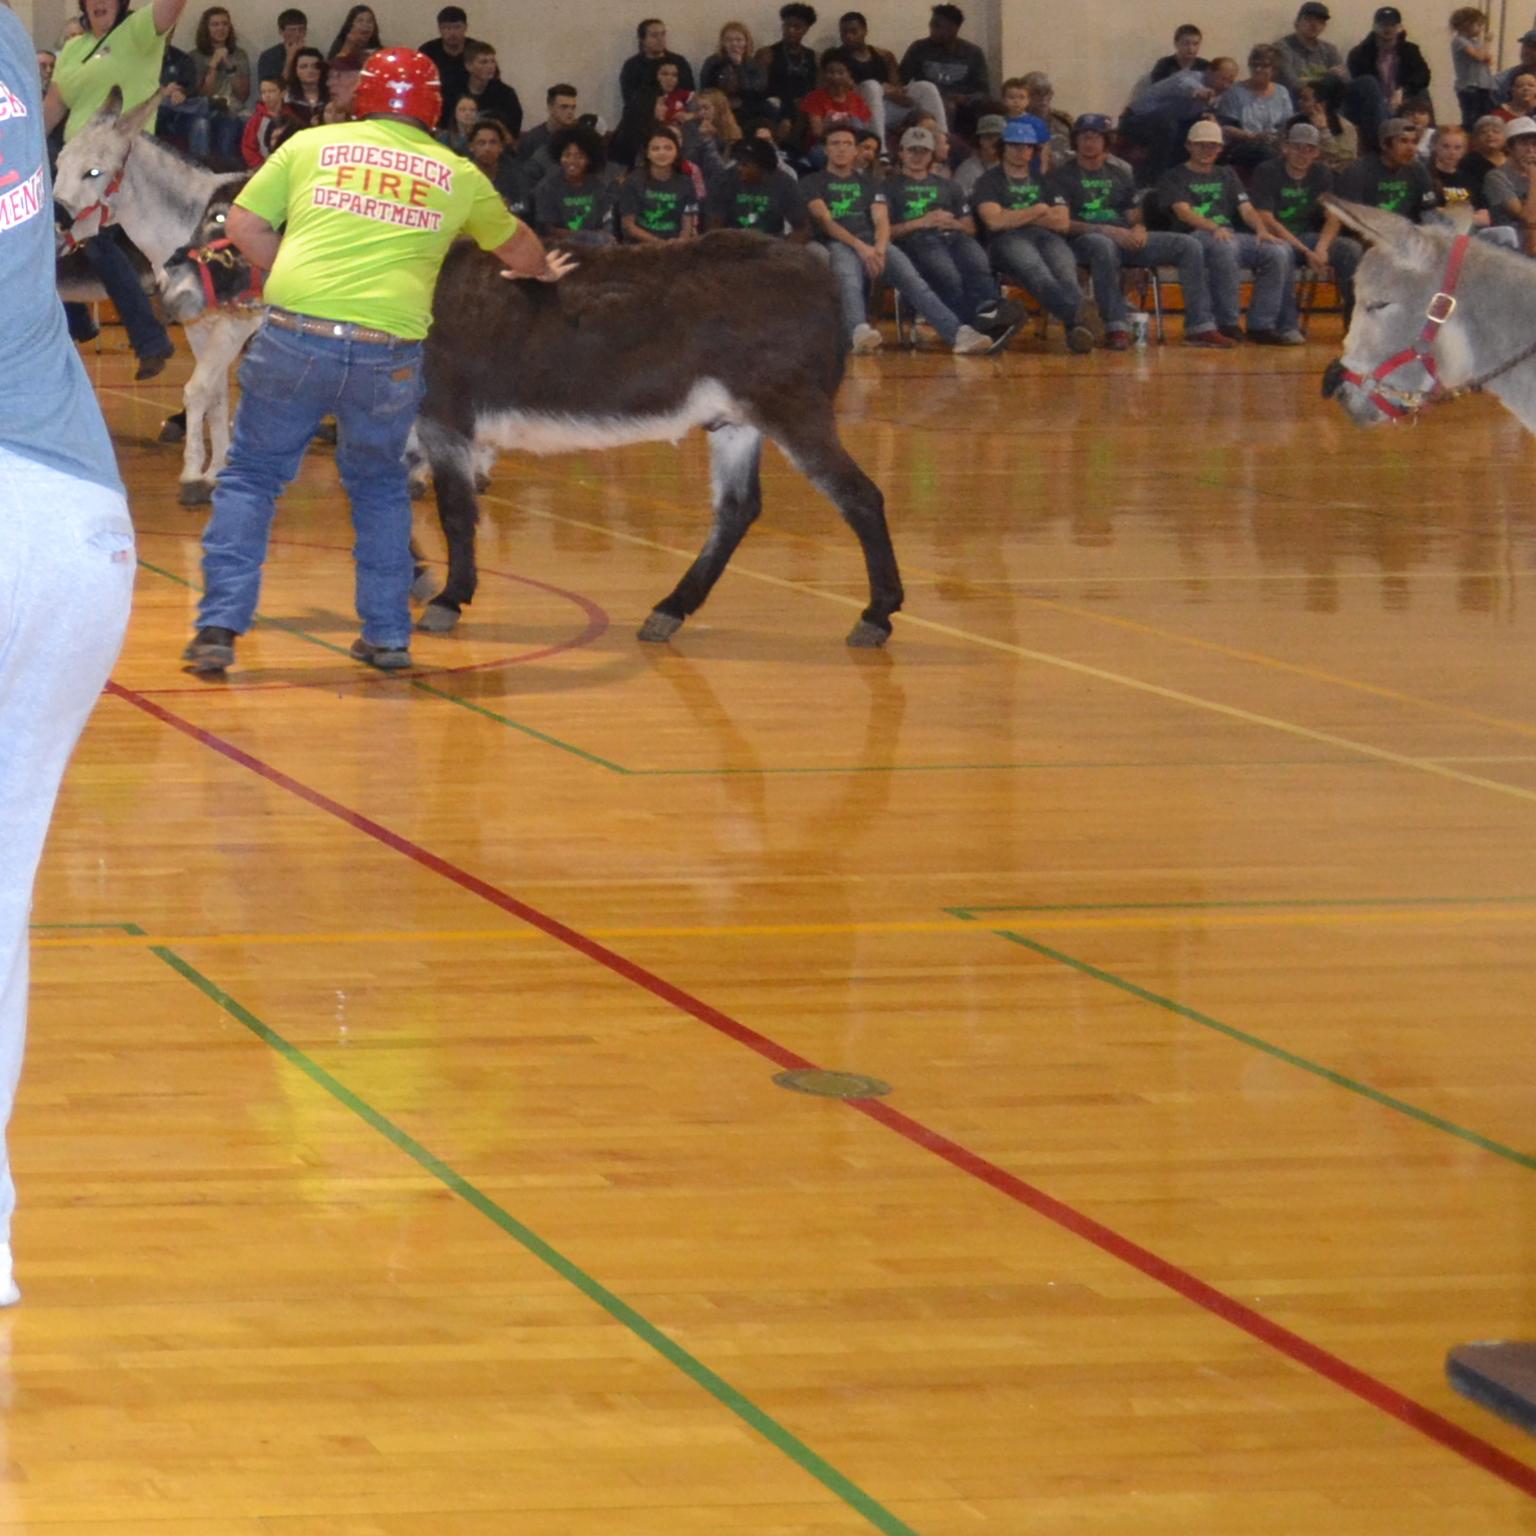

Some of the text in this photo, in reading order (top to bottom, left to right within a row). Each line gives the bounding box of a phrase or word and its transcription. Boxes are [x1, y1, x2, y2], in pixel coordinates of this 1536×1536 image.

[320, 144, 452, 192] GROESBECK
[336, 165, 431, 208] FIRE
[313, 186, 442, 231] DEPARTMENT
